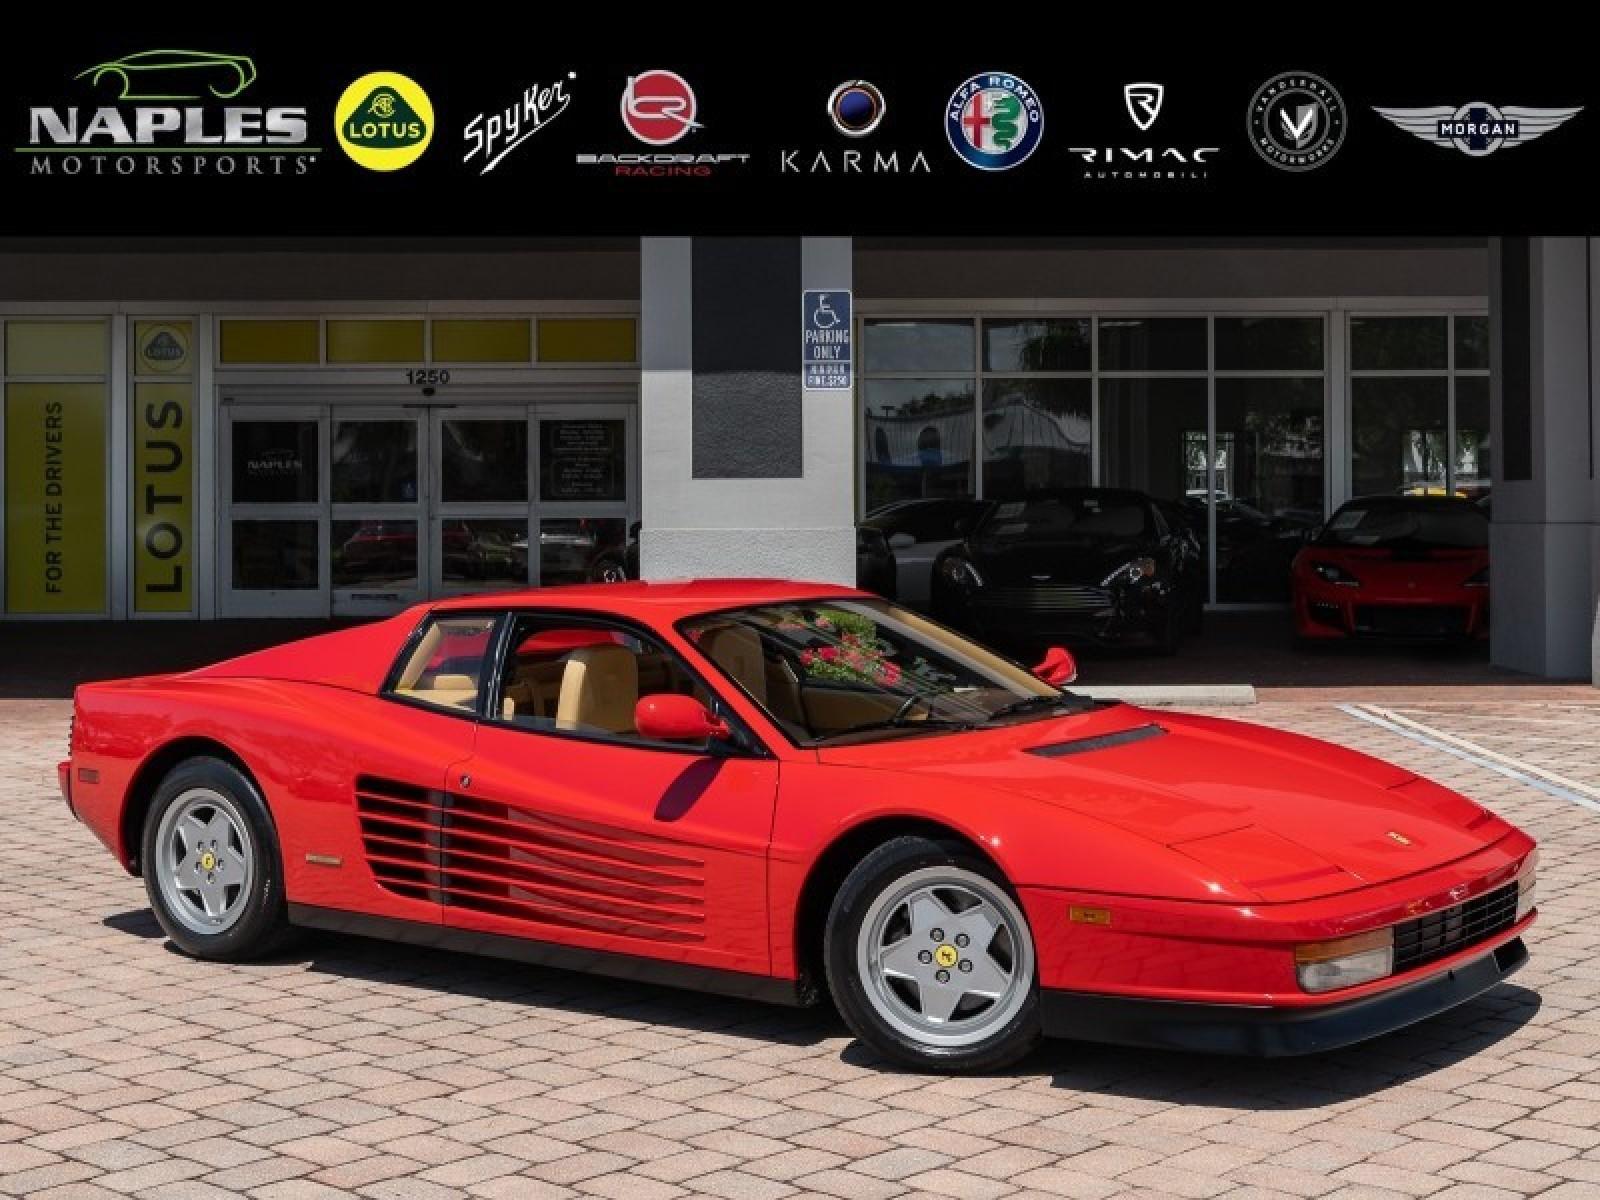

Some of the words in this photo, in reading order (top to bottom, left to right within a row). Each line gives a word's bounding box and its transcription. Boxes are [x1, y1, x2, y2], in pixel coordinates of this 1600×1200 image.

[805, 329, 849, 344] PARKING
[813, 345, 841, 359] ONLY
[405, 368, 451, 385] 1250
[45, 400, 63, 497] DRIVERS
[145, 400, 184, 593] LOTUS
[45, 503, 63, 545] THE
[45, 551, 63, 594] FOR
